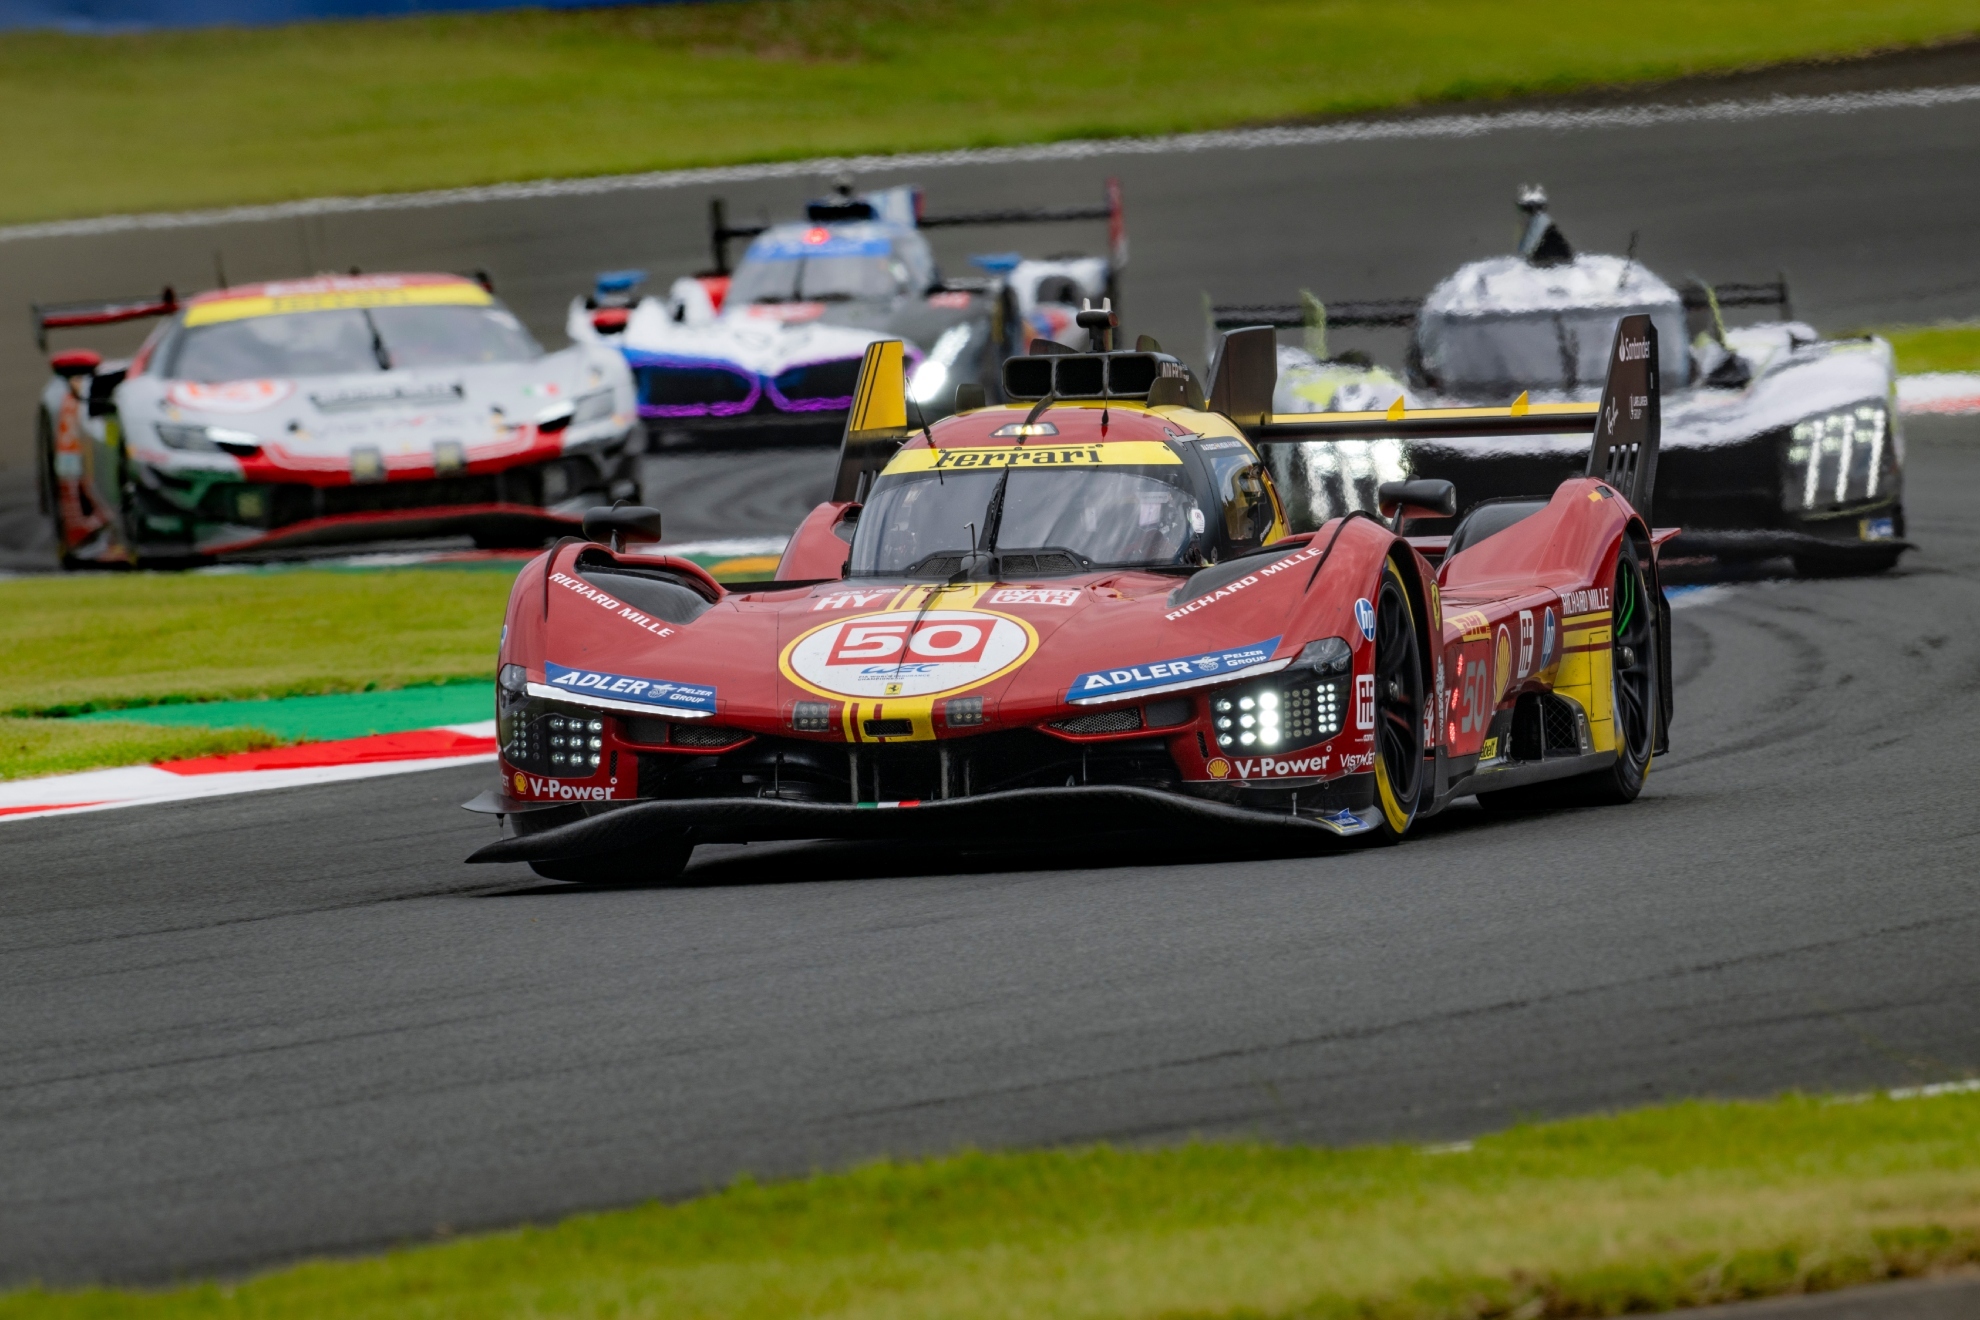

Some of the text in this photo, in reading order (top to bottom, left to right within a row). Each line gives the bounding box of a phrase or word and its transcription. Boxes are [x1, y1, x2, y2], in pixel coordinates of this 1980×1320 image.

[1625, 336, 1650, 360] Santander
[929, 445, 1103, 468] Ferrari
[1165, 547, 1323, 621] RICHARD MILLE
[548, 572, 675, 637] RICHARD MILLE
[813, 594, 882, 611] HY
[996, 594, 1070, 604] CAR
[1560, 587, 1609, 615] RICHARD MILLE
[1359, 599, 1376, 640] hp
[837, 625, 982, 659] 50
[1223, 649, 1264, 660] PELZER
[1226, 655, 1267, 667] GROUP
[552, 671, 650, 695] ADLER
[1084, 661, 1193, 690] ADLER
[669, 693, 705, 703] GROUP
[677, 686, 713, 697] PELZER
[1462, 658, 1487, 733] 50
[1235, 755, 1330, 779] V-Power
[529, 777, 615, 800] V-Power
